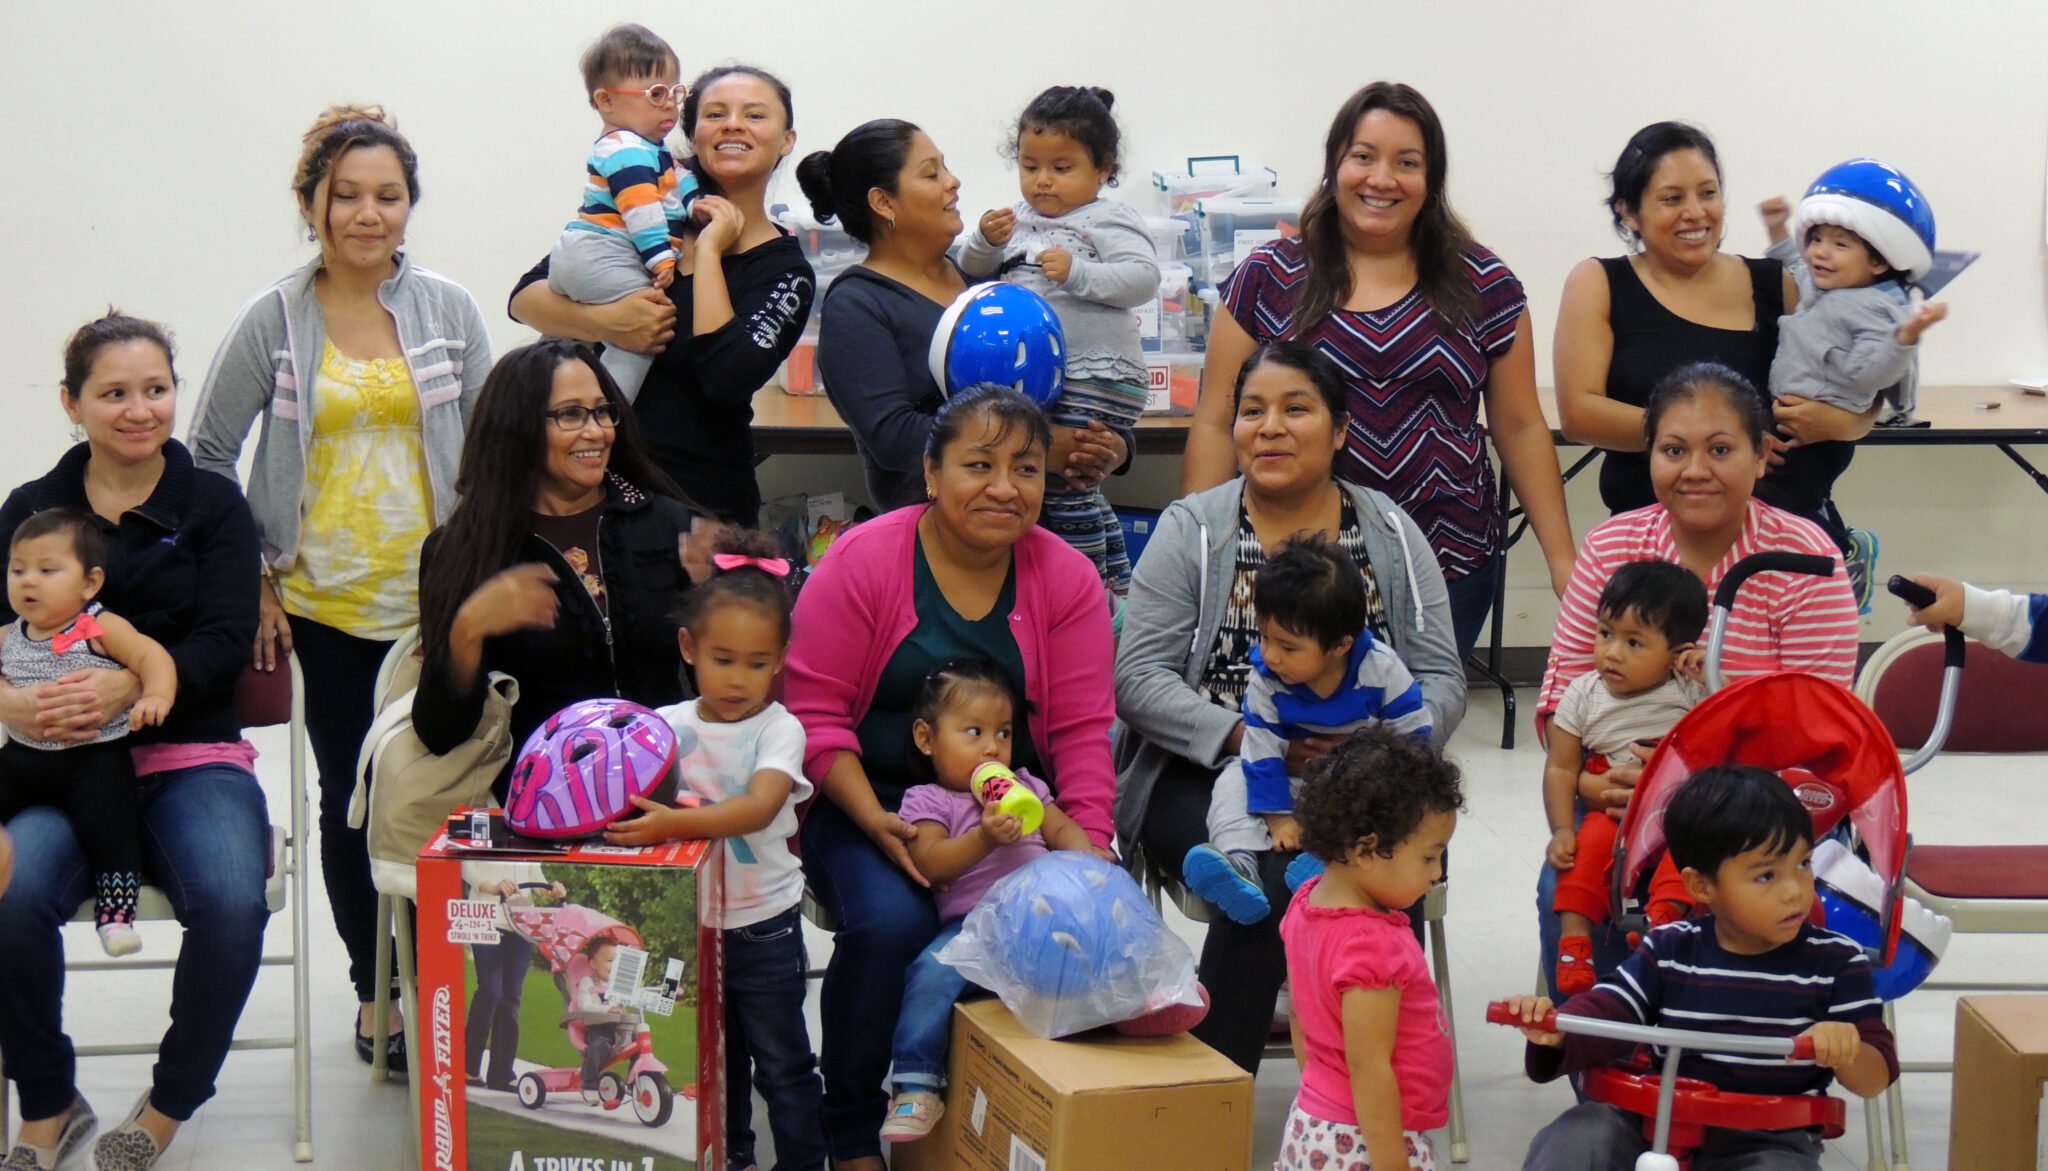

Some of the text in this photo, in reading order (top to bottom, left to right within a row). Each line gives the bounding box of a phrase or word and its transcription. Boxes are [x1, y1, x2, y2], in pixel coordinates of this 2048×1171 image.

[450, 902, 497, 919] DELUXE
[455, 920, 493, 931] 4-IN-1
[450, 931, 471, 940] STROLL
[481, 932, 497, 941] TRIKE
[433, 987, 453, 1171] RADIO FLYER
